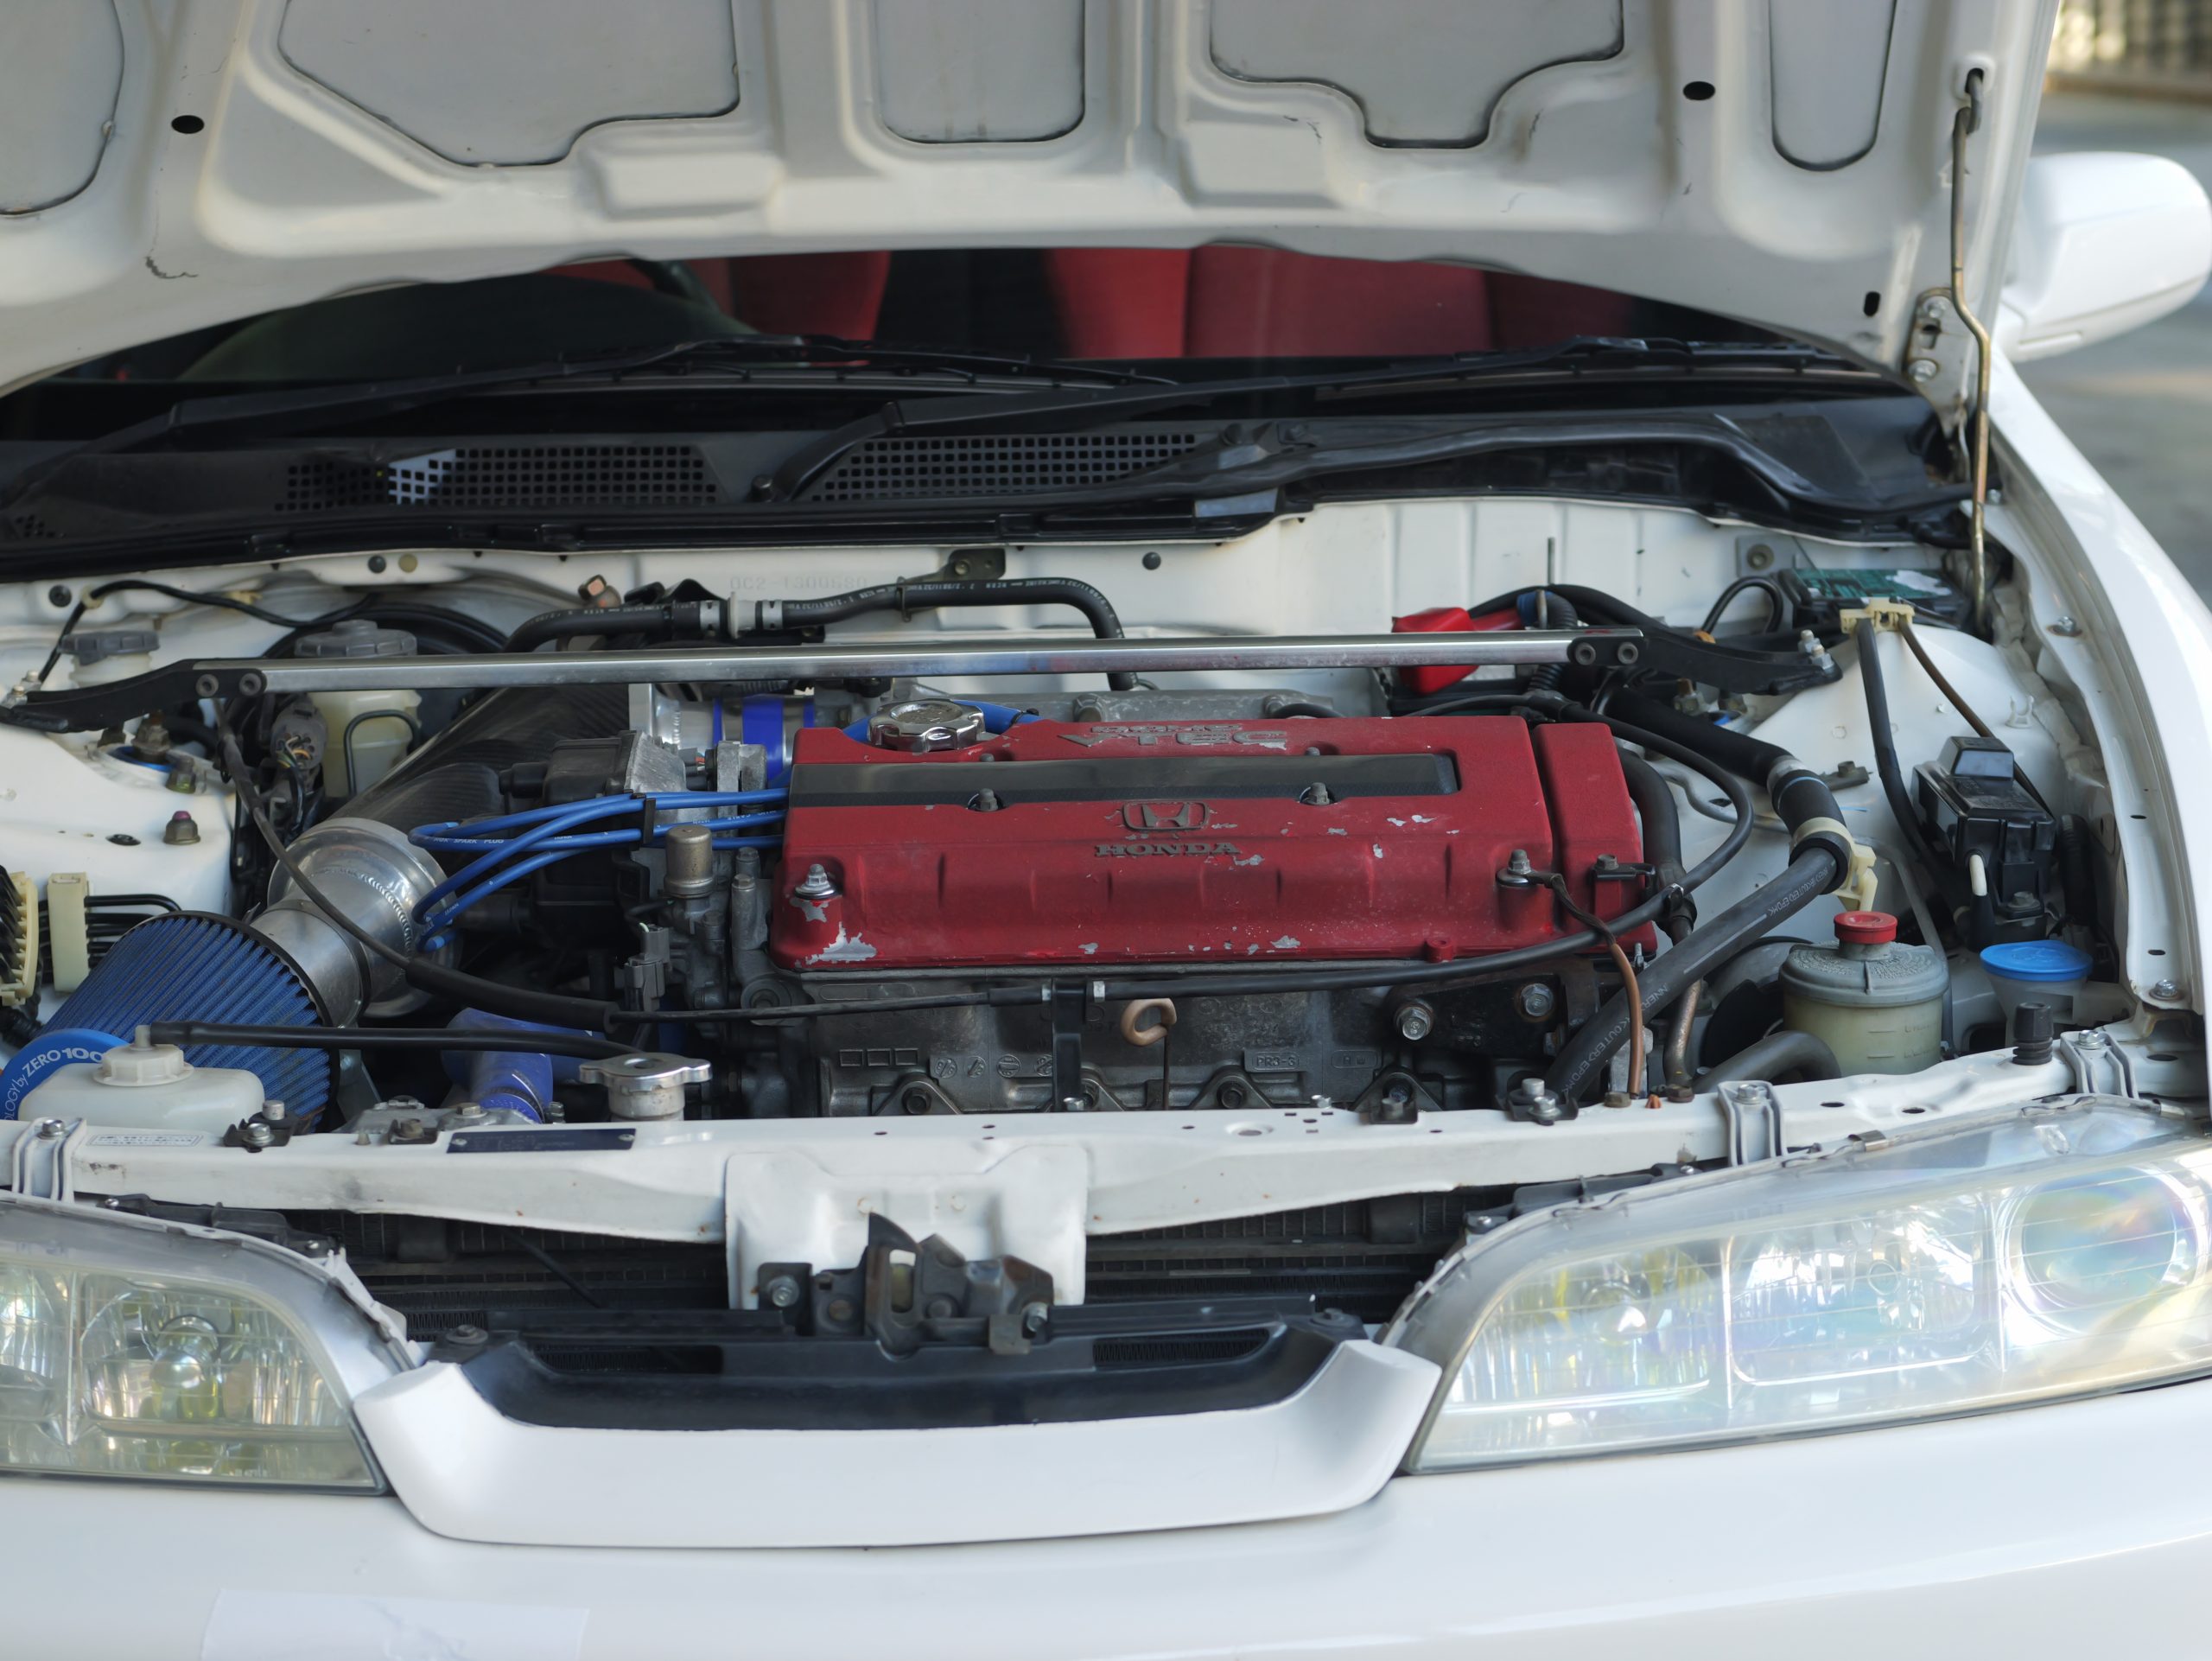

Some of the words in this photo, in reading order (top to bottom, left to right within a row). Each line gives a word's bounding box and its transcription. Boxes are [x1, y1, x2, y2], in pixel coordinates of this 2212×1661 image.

[1057, 731, 1287, 749] VTEC
[1094, 843, 1242, 856] HONDA
[11, 1074, 29, 1087] by
